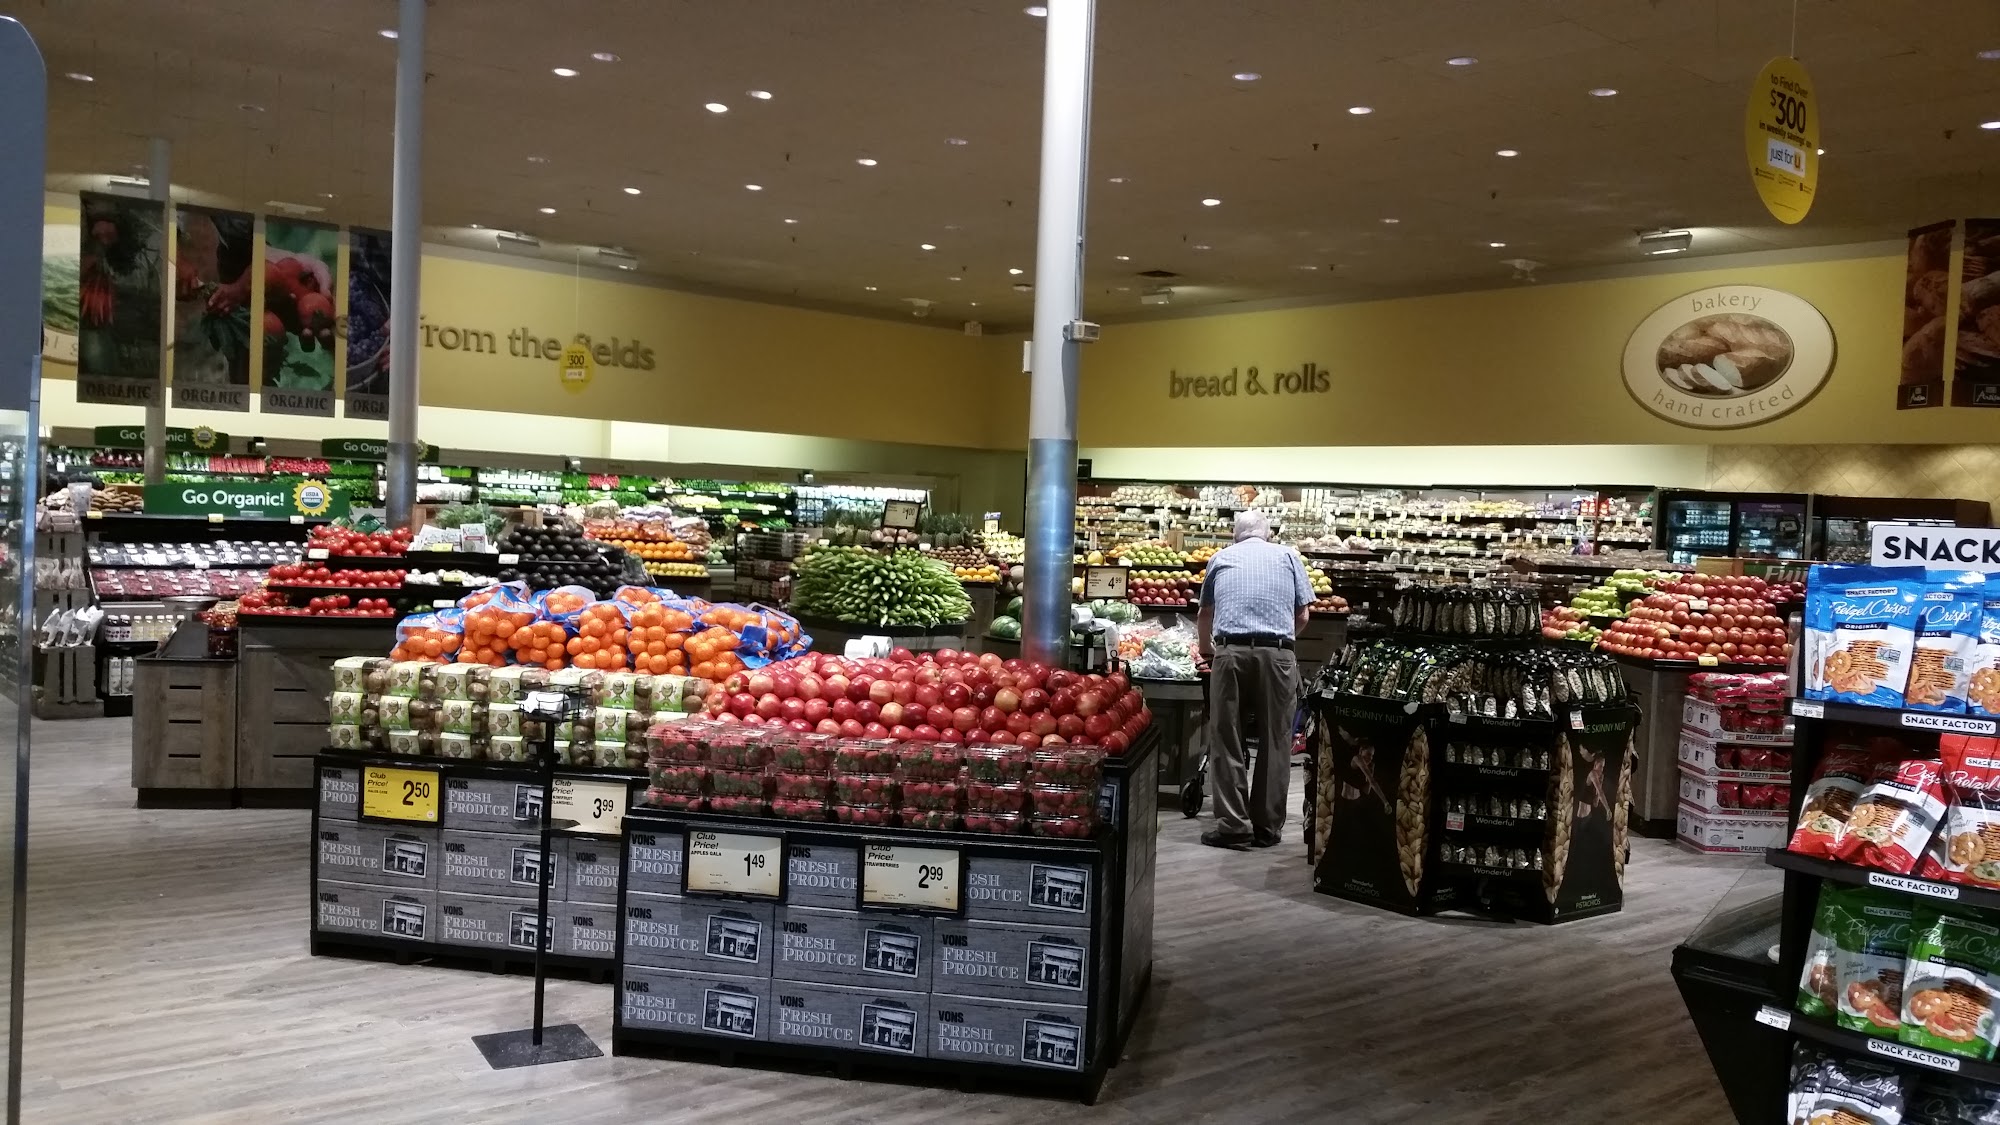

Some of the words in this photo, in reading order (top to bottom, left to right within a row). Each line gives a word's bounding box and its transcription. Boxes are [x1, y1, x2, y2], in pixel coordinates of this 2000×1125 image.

[1779, 76, 1794, 92] Find
[1770, 89, 1807, 134] $300
[1770, 147, 1783, 162] just
[1784, 149, 1794, 164] for
[1692, 292, 1762, 312] bakery
[507, 327, 562, 361] the
[1168, 367, 1238, 399] bread
[1244, 366, 1269, 396] &
[1273, 362, 1331, 395] rolls
[86, 383, 152, 400] ORGANIC
[180, 388, 243, 406] ORGANIC
[269, 393, 329, 411] ORGANIC
[353, 400, 389, 415] ORGA
[1652, 388, 1704, 418] hand
[1711, 385, 1795, 419] crafted
[119, 429, 138, 441] Go
[343, 441, 359, 452] Go
[182, 488, 209, 505] Go
[212, 489, 285, 509] Organic!
[1184, 540, 1215, 548] locally
[1882, 535, 2000, 564] SNACK
[1868, 588, 1897, 596] FACTORY
[1870, 599, 1912, 620] Crisps
[1926, 605, 1972, 623] Crisps
[1335, 706, 1350, 717] THE
[1351, 708, 1384, 722] SKINNY
[1385, 713, 1404, 725] NUT
[1481, 718, 1522, 728] Wonderful
[1905, 715, 1939, 726] SNACK
[1942, 719, 1992, 731] FACTORY
[1591, 723, 1613, 733] SKINNY
[1614, 721, 1627, 731] NUT
[322, 769, 342, 779] VONS
[1479, 767, 1519, 777] Wonderful
[447, 780, 469, 790] VONS
[552, 787, 574, 795] Price!
[322, 790, 357, 803] PROD
[447, 789, 492, 804] FRESH
[447, 801, 509, 816] PRODUCE
[1476, 817, 1515, 827] Wonderful
[320, 831, 339, 841] VONS
[631, 833, 656, 846] VONS
[696, 832, 716, 840] Club
[320, 841, 361, 856] FRESH
[445, 842, 466, 853] VONS
[693, 841, 719, 850] Price!
[320, 852, 378, 869] PRODUCE
[445, 852, 488, 867] FRESH
[575, 852, 597, 862] VONS
[631, 846, 682, 862] FRESH
[867, 852, 894, 861] Price!
[444, 864, 506, 880] PRODUCE
[788, 858, 839, 875] FRESH
[1473, 866, 1512, 877] Wonderful
[967, 873, 1001, 887] ESH
[1871, 874, 1904, 888] SNACK
[1906, 881, 1955, 897] FACTORY
[320, 892, 338, 903] VONS
[968, 887, 1022, 902] ODUCE
[320, 903, 360, 917] FRESH
[443, 905, 464, 916] VONS
[1575, 899, 1601, 909] PISTACHIOS
[628, 907, 652, 919] VONS
[1865, 907, 1888, 915] SNACK
[1889, 909, 1911, 918] FACTO
[320, 914, 377, 930] PRODUCE
[443, 915, 486, 930] FRESH
[572, 916, 594, 927] VONS
[628, 918, 679, 936] FRESH
[783, 922, 808, 934] VONS
[443, 927, 504, 943] PRODUCE
[626, 932, 699, 951] PRODUCE
[783, 933, 836, 951] FRESH
[942, 934, 968, 947] VONS
[782, 947, 857, 966] PRODUCE
[942, 947, 997, 964] FRESH
[1930, 956, 1952, 965] GARLIC
[941, 960, 1019, 979] PRODUCE
[625, 980, 649, 993] VONS
[625, 992, 676, 1010] FRESH
[779, 995, 804, 1008] VONS
[624, 1005, 697, 1026] PRODUCE
[779, 1007, 832, 1026] FRESH
[938, 1010, 964, 1023] VONS
[779, 1021, 853, 1042] PRODUCE
[938, 1022, 993, 1041] FRESH
[938, 1036, 1015, 1058] PRODUCE
[1870, 1041, 1904, 1056] SNACK
[1906, 1051, 1956, 1069] FACTORY
